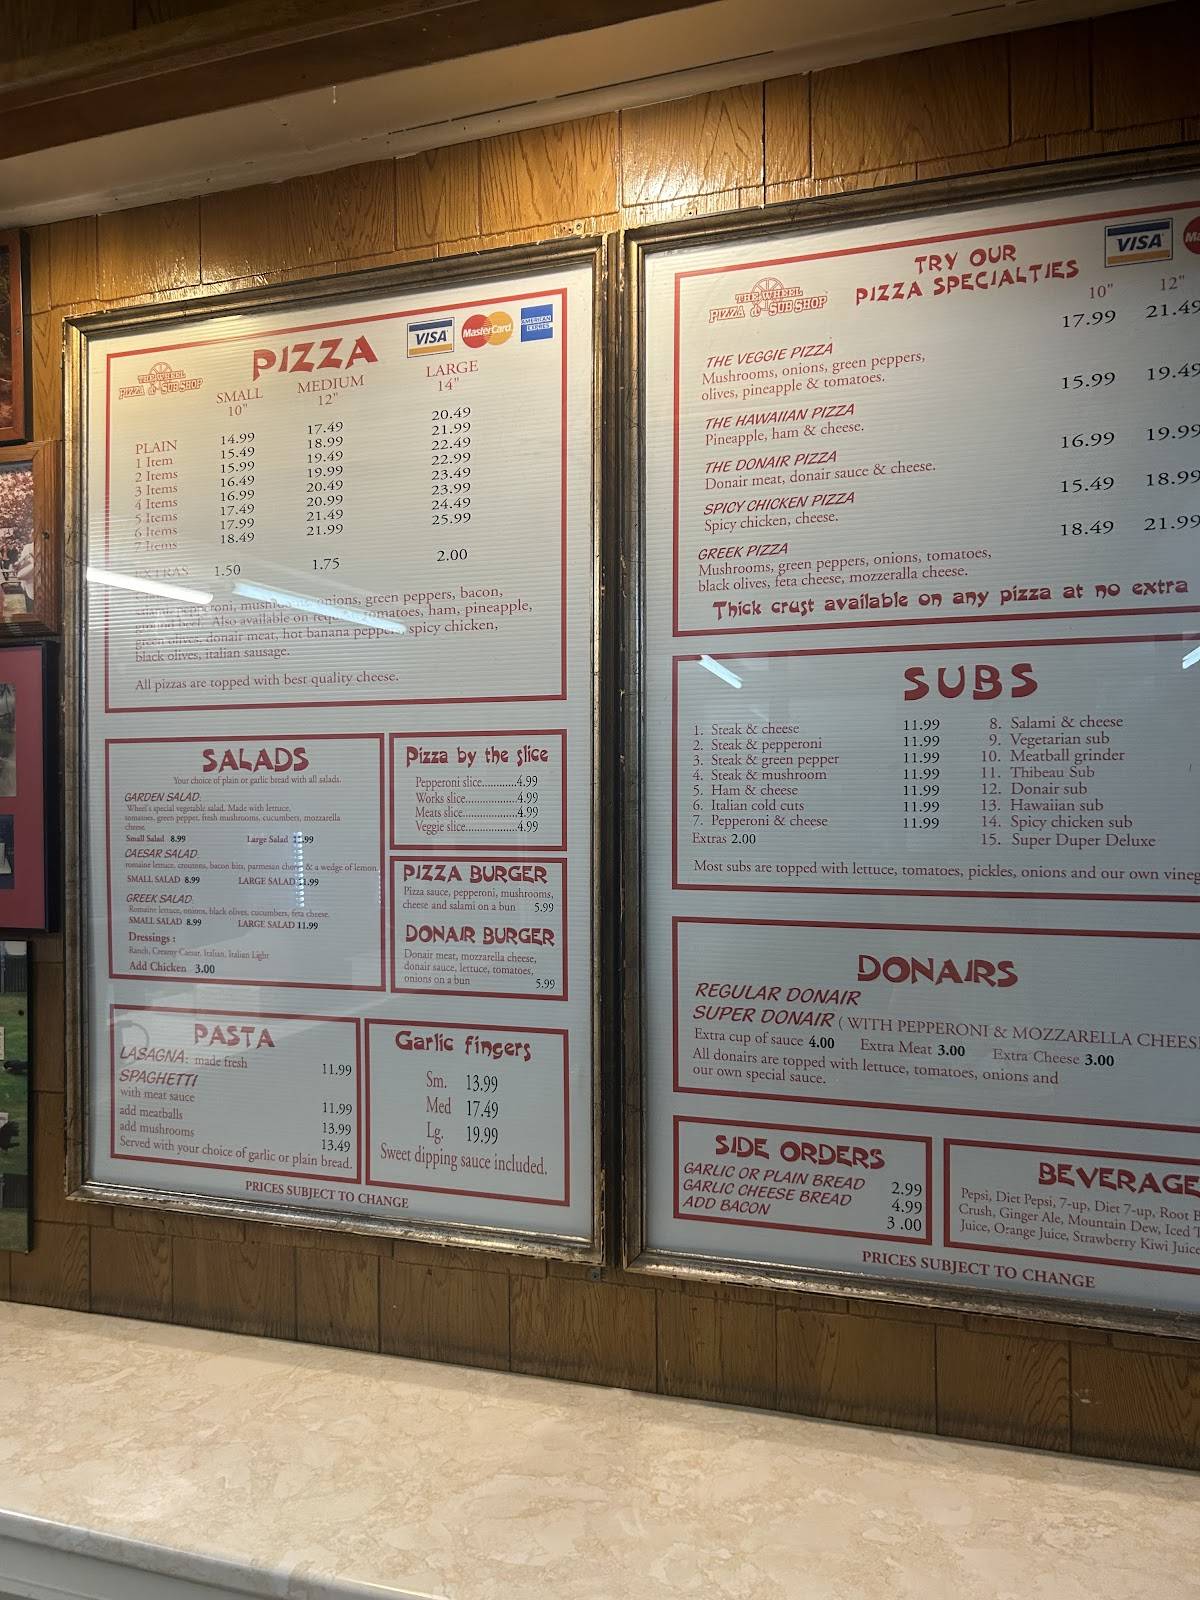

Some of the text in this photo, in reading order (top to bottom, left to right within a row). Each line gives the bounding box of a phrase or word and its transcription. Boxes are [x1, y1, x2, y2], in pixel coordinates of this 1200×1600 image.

[1117, 233, 1162, 252] VISA
[914, 244, 1016, 274] TRY OUR
[856, 259, 1080, 306] PIZZA SPECIALTIES
[1090, 283, 1114, 299] 10"
[1161, 274, 1185, 291] 12"
[735, 287, 803, 304] THE WHEEL
[709, 306, 745, 323] PIZZA
[769, 300, 793, 316] SUB
[794, 296, 828, 312] SHOP
[1063, 310, 1116, 328] 17.99
[415, 330, 447, 345] VISA
[463, 323, 512, 339] MasterCard
[253, 335, 378, 384] PIZZA
[707, 342, 833, 368] THE VEGGIE PIZZA
[426, 360, 478, 378] LARGE
[702, 353, 925, 386] Mushrooms, onions, green peppers,
[297, 375, 364, 397] MEDIUM
[439, 377, 459, 392] 14"
[1063, 372, 1115, 389] 15.99
[216, 387, 263, 404] SMALL
[319, 392, 338, 406] 12"
[229, 403, 248, 417] 10"
[432, 407, 471, 421] 20.49
[706, 403, 854, 430] THE HAWAIIAN PIZZA
[308, 421, 343, 435] 17.49
[432, 422, 471, 436] 21.99
[136, 440, 177, 455] PLAIN
[222, 432, 255, 445] 14.99
[308, 436, 343, 449] 18.99
[431, 437, 471, 451] 22.49
[221, 446, 255, 459] 15.49
[136, 456, 173, 469] 1 Item
[703, 491, 855, 516] SPICY CHICKEN PIZZA
[437, 548, 468, 562] 2.00
[698, 542, 788, 560] GREEK PIZZA
[215, 564, 241, 577] 1.50
[313, 557, 340, 570] 1.75
[365, 586, 503, 608] green peppers, bacon,
[712, 579, 1188, 621] Thick crust available on any pizza at no extra
[135, 671, 399, 693] All pizzas are topped with best quality cheese.
[904, 663, 1038, 701] SUBS
[693, 722, 799, 736] 1. Steak & cheese
[904, 719, 940, 731] 11.99
[202, 747, 309, 773] SALADS
[406, 745, 548, 768] Pizza by the slice
[982, 747, 1125, 765] 10. Meatball grinder
[982, 832, 1156, 850] 15. Super Duper Deluxe
[403, 864, 548, 884] PIZZA BURGER
[404, 886, 554, 900] Pizza sauce, pepperoni, mushrooms,
[534, 902, 554, 913] 5.99
[128, 931, 170, 946] Dressings
[405, 924, 555, 947] DONAIR BURGER
[129, 960, 215, 974] Add Chicken 3.00
[857, 954, 1018, 988] DONAIRS
[695, 982, 862, 1006] REGULAR DONAIR
[693, 1005, 835, 1028] SUPER DONAIR
[194, 1023, 277, 1050] PASTA
[395, 1030, 531, 1062] Garlic fingers
[860, 1038, 965, 1057] Extra Meat 3.00
[194, 1055, 248, 1069] made fresh
[992, 1048, 1114, 1066] Extra Cheese 3.00
[119, 1069, 199, 1088] SPAGHETTI
[426, 1070, 498, 1093] Sm. 13.99
[120, 1086, 195, 1102] with meat sauce
[119, 1104, 183, 1120] add meatballs
[323, 1102, 353, 1116] 11.99
[426, 1096, 499, 1119] Med 17.49
[323, 1122, 351, 1136] 13.99
[426, 1121, 498, 1145] Lg. 19.99
[715, 1135, 885, 1170] SIDE ORDERS
[684, 1162, 866, 1190] GARLIC OR PLAIN BREAD
[245, 1180, 409, 1209] PRICES SUBJECT TO CHANGE
[891, 1181, 922, 1197] 2.99
[682, 1195, 771, 1215] ADD BACON
[863, 1251, 1095, 1288] PRICES SUBJECT TO CHANGE
